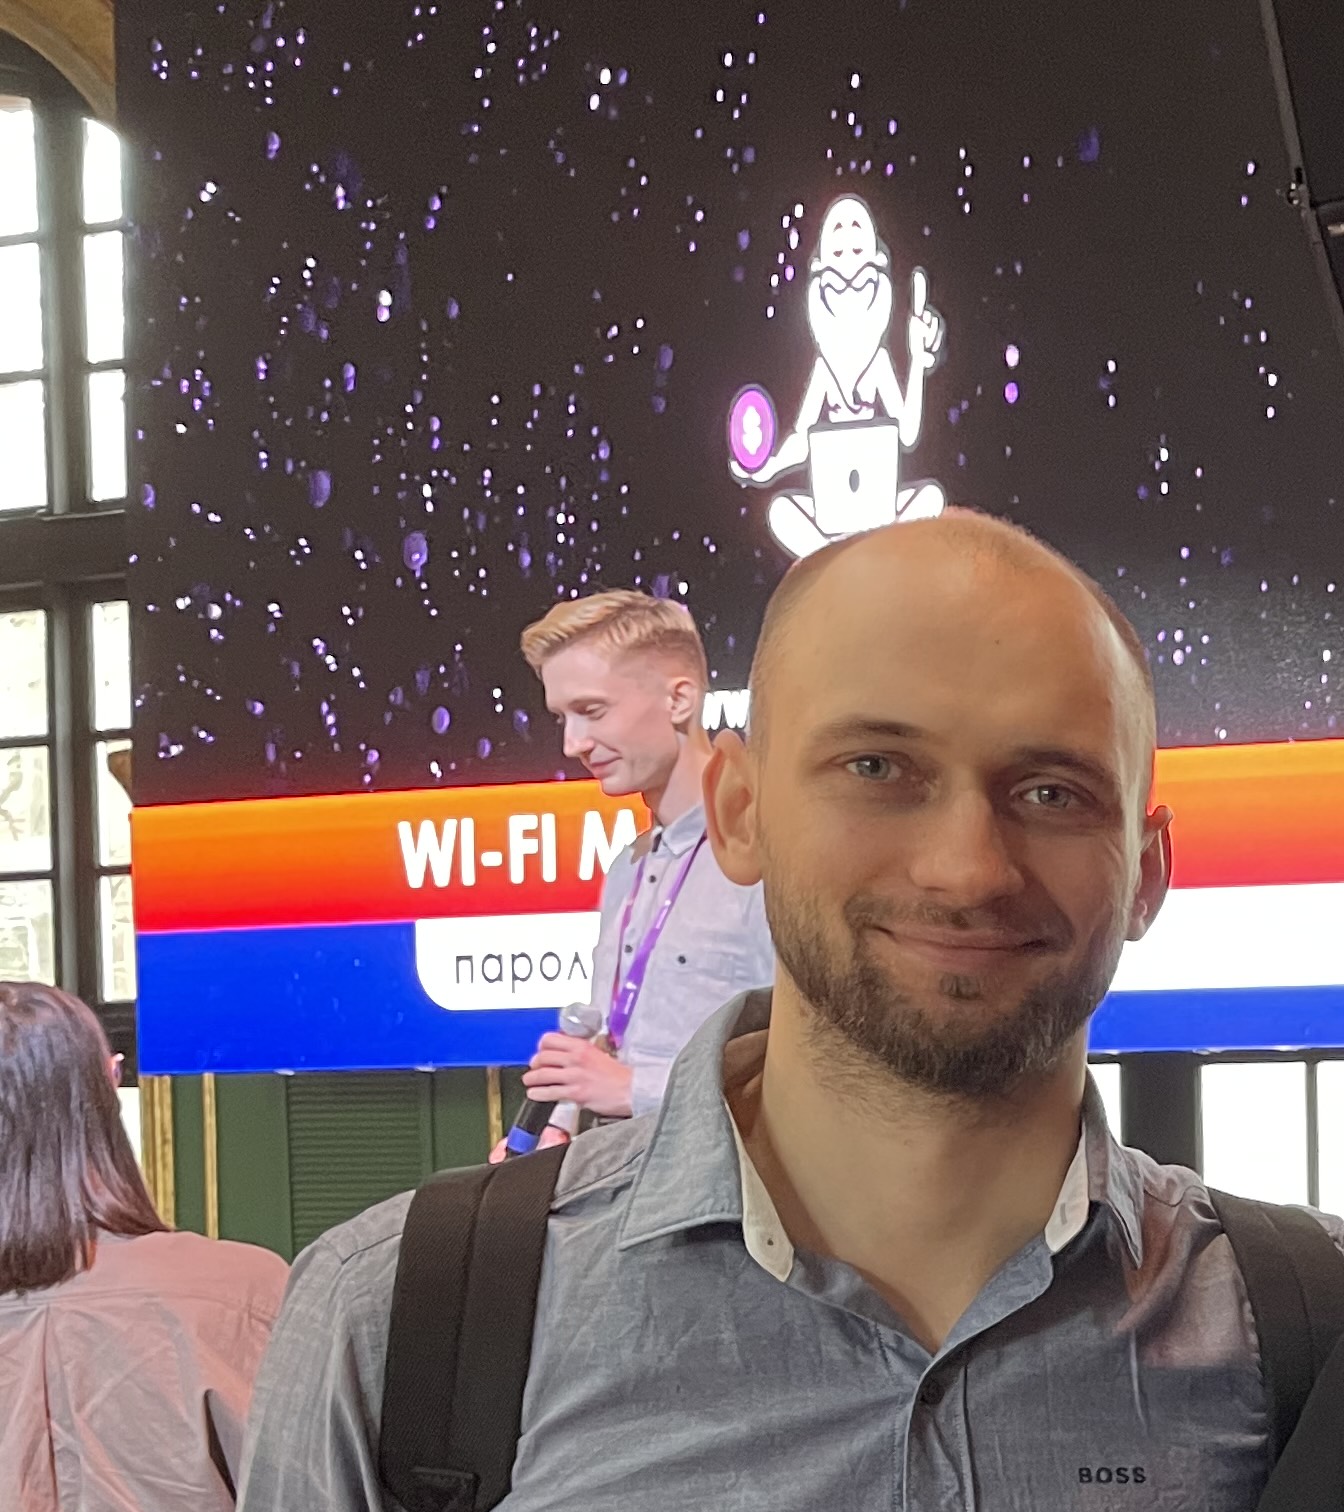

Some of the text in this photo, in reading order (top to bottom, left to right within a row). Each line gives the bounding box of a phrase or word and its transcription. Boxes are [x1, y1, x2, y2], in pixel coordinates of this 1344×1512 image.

[397, 812, 557, 889] WI-FI
[455, 951, 588, 994] парол
[1078, 1466, 1147, 1484] BOSS
